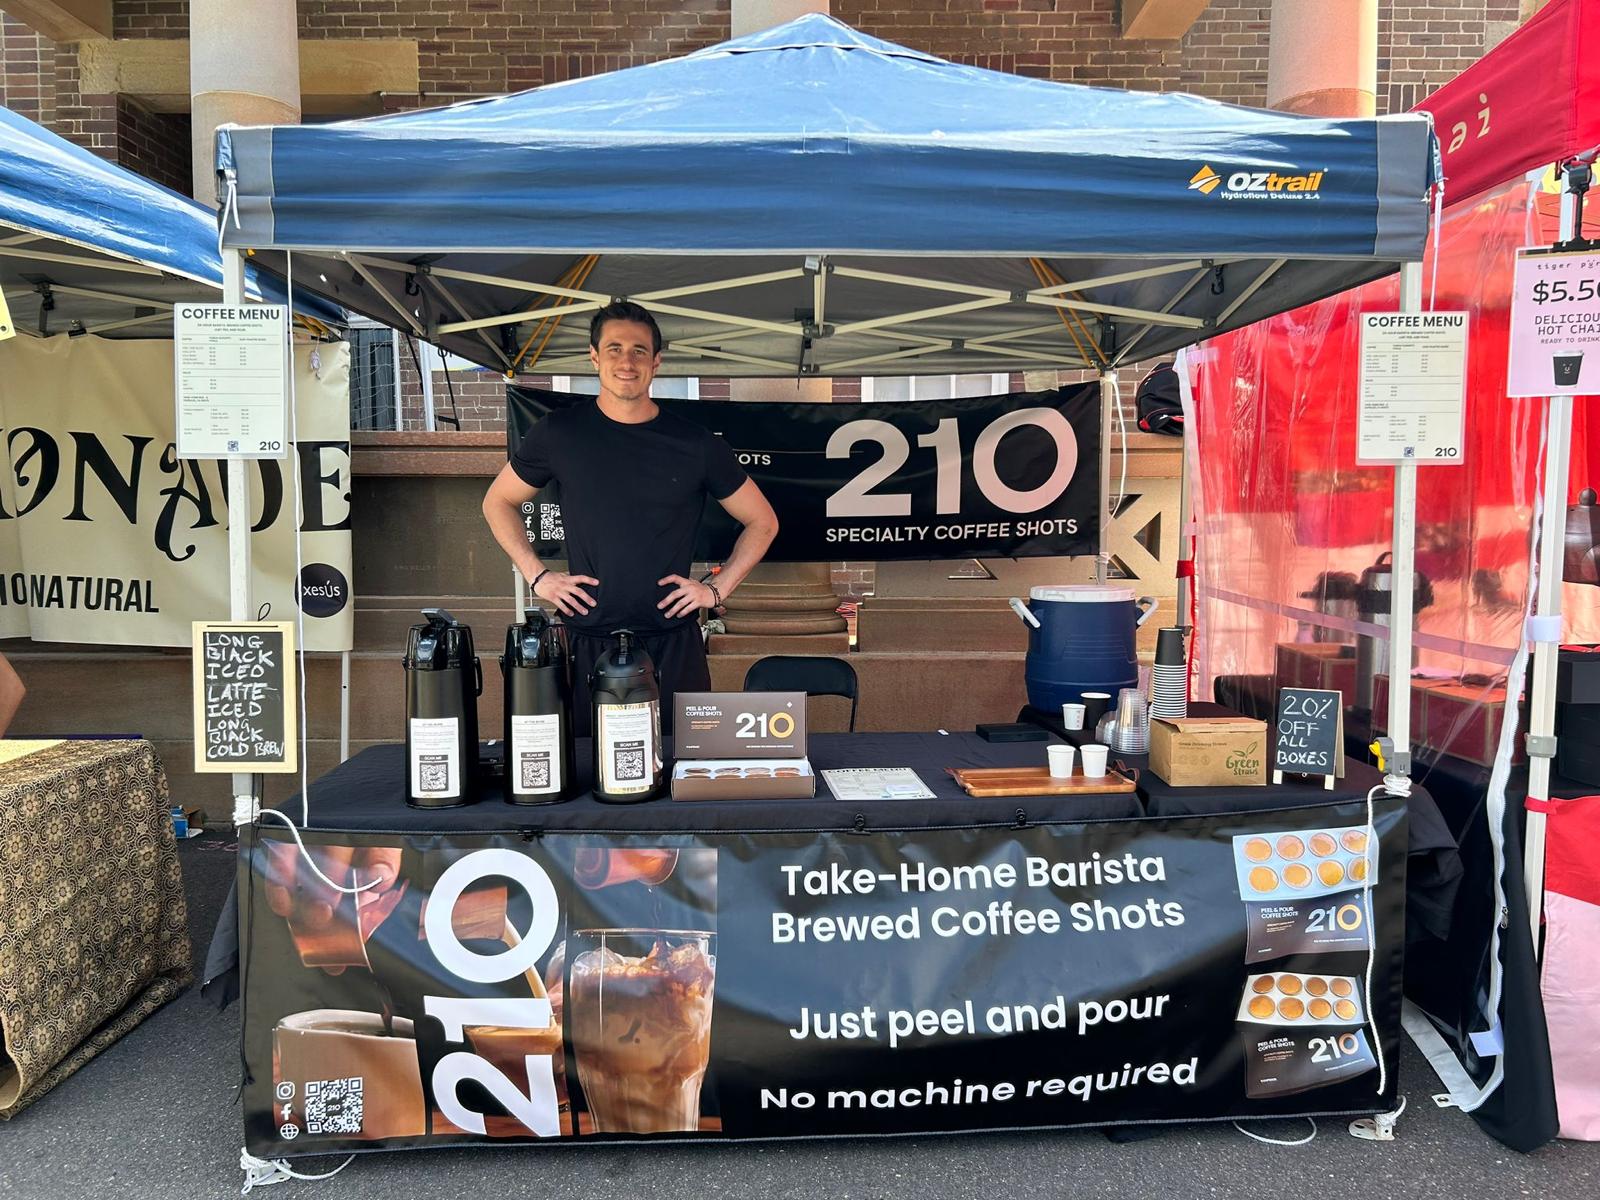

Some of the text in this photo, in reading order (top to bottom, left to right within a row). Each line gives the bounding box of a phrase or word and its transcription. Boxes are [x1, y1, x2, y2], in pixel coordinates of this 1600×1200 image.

[1227, 172, 1323, 191] OZtrail
[1221, 191, 1268, 200] Hydroflow
[1270, 192, 1303, 200] Deluxe
[1538, 262, 1571, 270] tiger
[1532, 280, 1600, 305] $5.5
[182, 308, 280, 320] COFFEE MENU
[1368, 316, 1463, 327] COFFEE MENU
[1538, 325, 1563, 336] HOT
[259, 441, 281, 451] 210
[1435, 447, 1457, 457] 210
[735, 453, 772, 465] OTS
[826, 407, 1078, 517] 210
[0, 427, 352, 561] ONADE
[826, 518, 1078, 542] SPECIALTY COFFEE SHOTS
[303, 580, 340, 598] xesús
[206, 632, 264, 648] LONG
[206, 663, 265, 680] ICED
[208, 682, 268, 703] LATTE
[207, 702, 262, 717] ICED
[1284, 695, 1333, 719] 20%
[207, 718, 250, 733] LONG
[736, 712, 795, 738] 210
[1279, 719, 1320, 736] OFF
[207, 741, 285, 758] COLD BREW
[1278, 735, 1308, 748] ALL
[1226, 755, 1260, 769] Green
[1277, 750, 1327, 766] BOXES
[781, 852, 1166, 896] Take-Home Barista
[772, 898, 1185, 944] Brewed Coffee Shots
[1305, 903, 1363, 934] 210
[424, 848, 561, 1138] 210
[789, 993, 1170, 1048] Just peel and pour
[1308, 1032, 1359, 1063] 210
[760, 1057, 1198, 1110] No machine required
